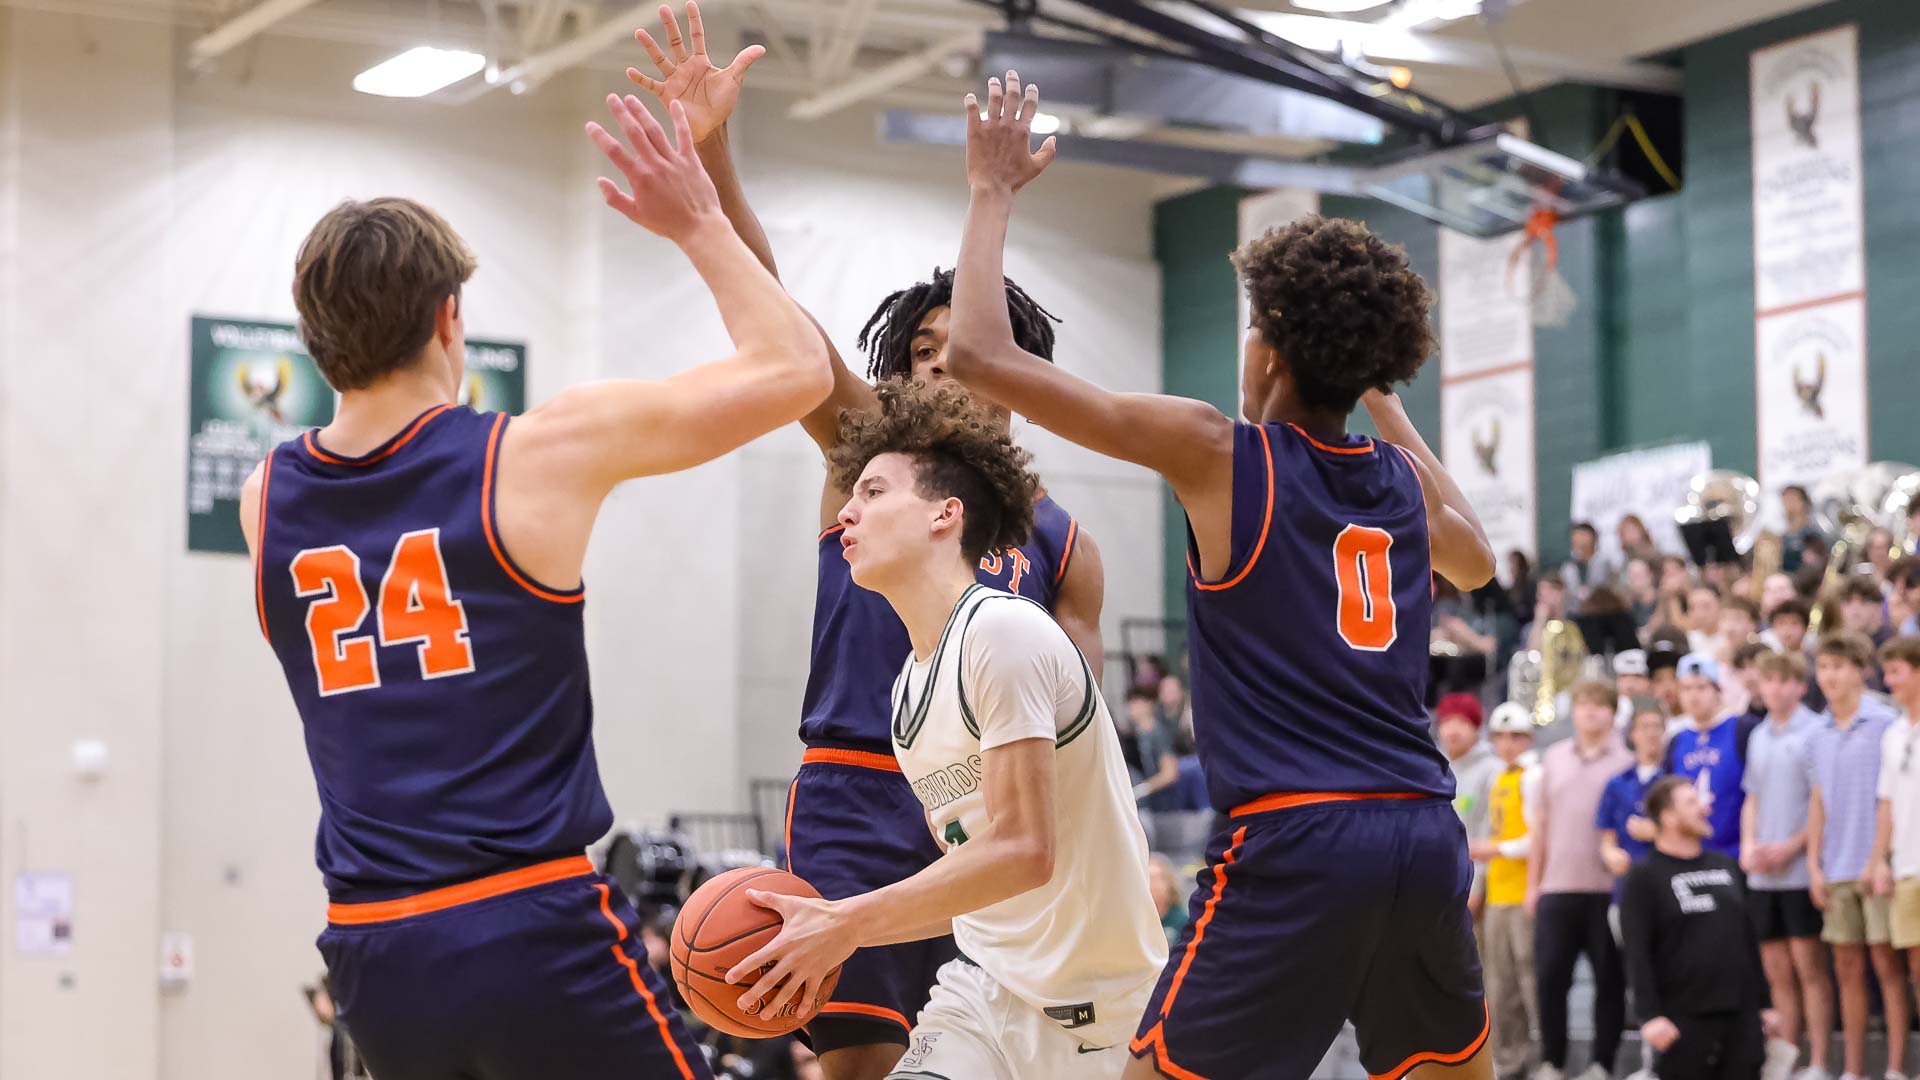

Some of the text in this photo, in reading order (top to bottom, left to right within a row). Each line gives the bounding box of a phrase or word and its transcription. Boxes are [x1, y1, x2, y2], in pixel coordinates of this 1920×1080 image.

[289, 527, 476, 697] 24
[1333, 523, 1397, 652] 0
[1078, 1010, 1089, 1021] M
